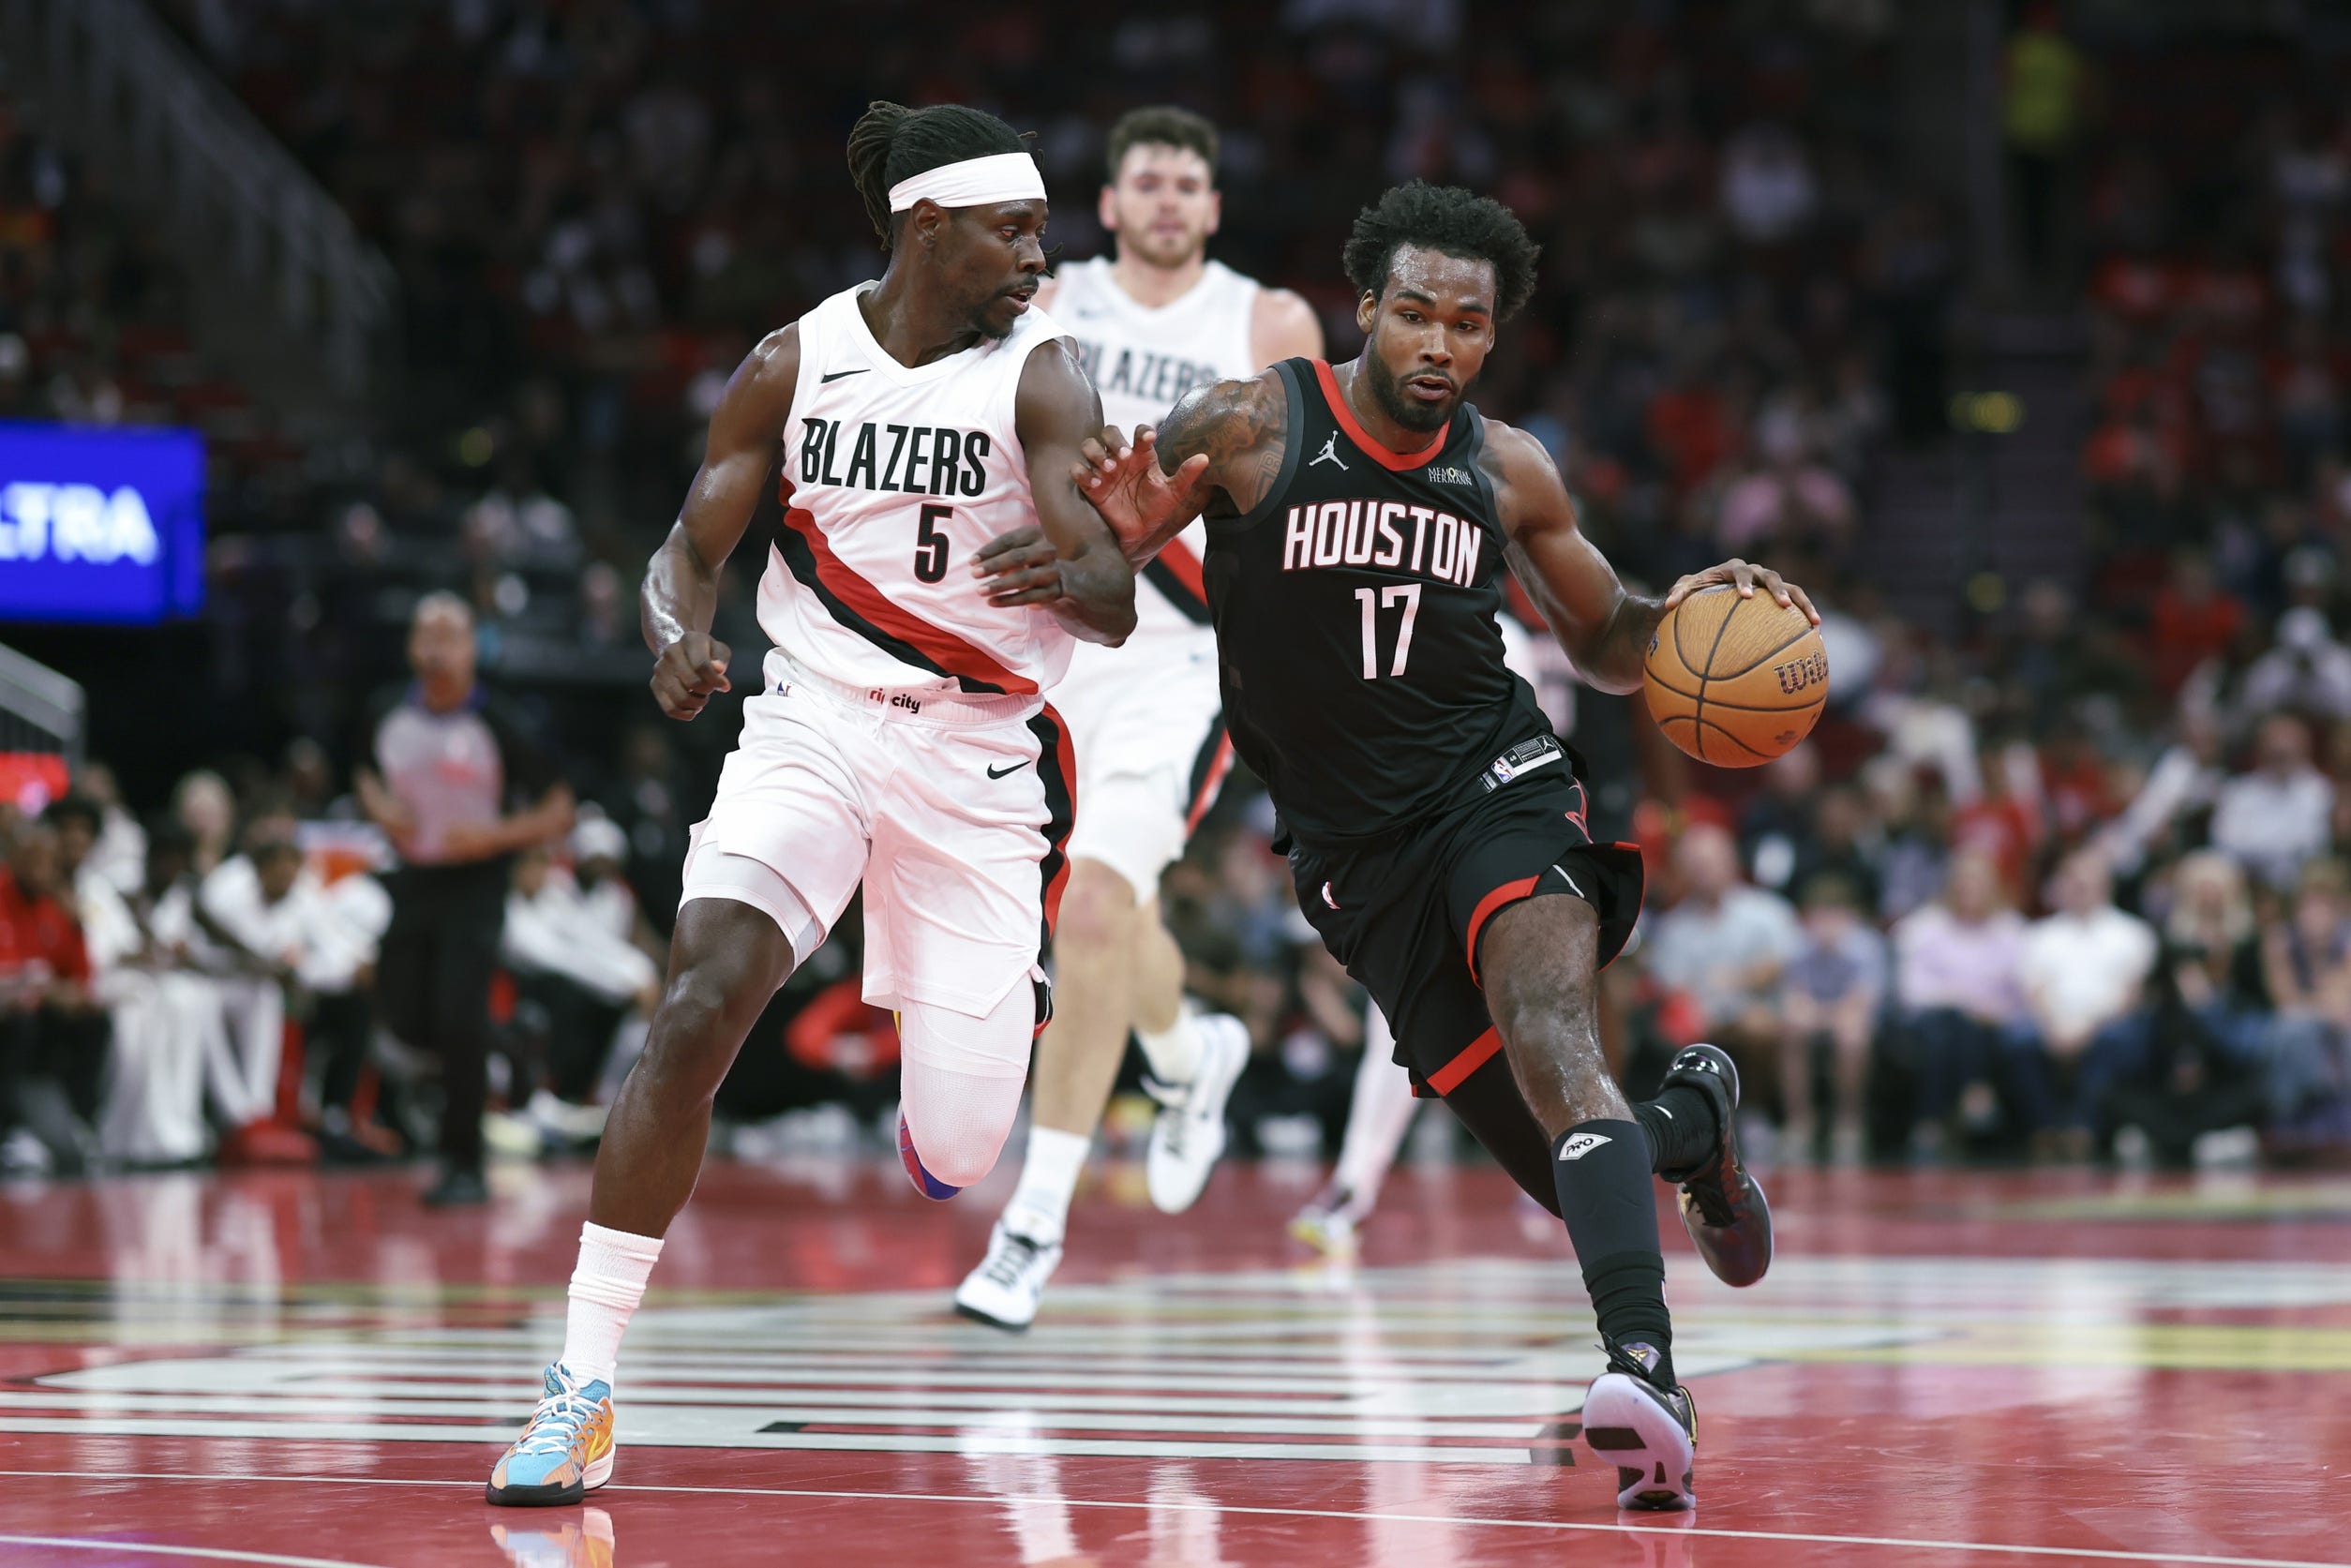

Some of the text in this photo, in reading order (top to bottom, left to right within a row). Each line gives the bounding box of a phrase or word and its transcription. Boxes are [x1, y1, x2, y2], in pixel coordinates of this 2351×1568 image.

[801, 418, 991, 497] BLAZERS
[1428, 467, 1470, 479] MEMORIAL
[1430, 473, 1472, 485] HERMANN
[914, 503, 953, 584] 5
[1282, 500, 1482, 589] HOUSTON
[1355, 583, 1422, 679] 17
[891, 694, 921, 714] city
